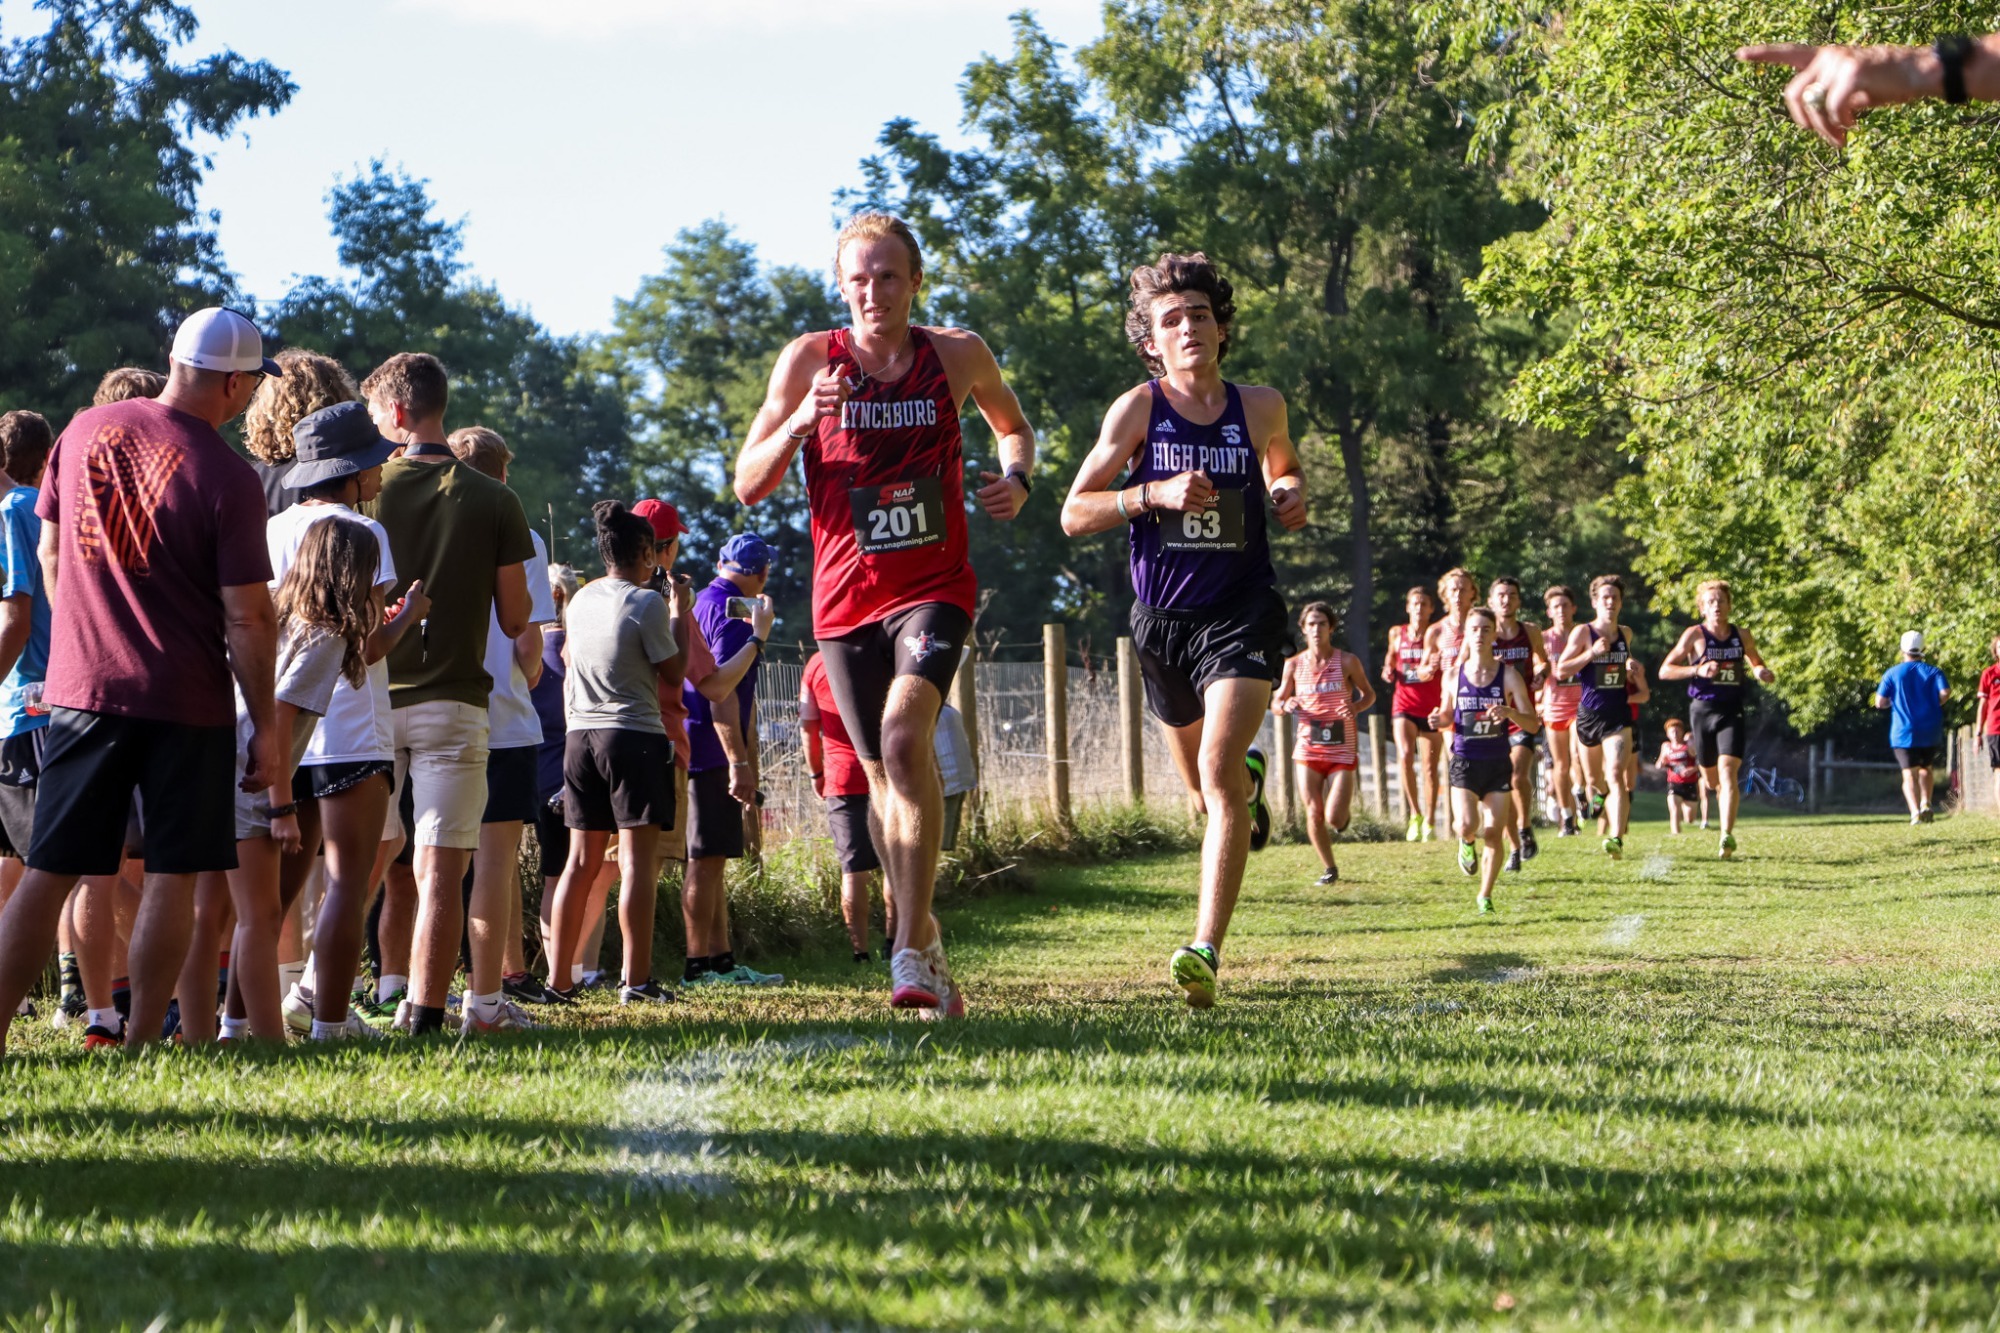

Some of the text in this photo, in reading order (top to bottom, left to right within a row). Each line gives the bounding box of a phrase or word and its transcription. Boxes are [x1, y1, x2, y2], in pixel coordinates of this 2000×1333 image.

[841, 399, 937, 429] LYNCHBURG
[1152, 442, 1249, 475] HIGH POINT
[868, 502, 928, 540] 201
[1182, 510, 1221, 539] 63
[864, 533, 939, 551] www.snaptiming.com
[1167, 541, 1237, 550] www.snaptiming.com
[1493, 647, 1530, 660] YNCHBURG
[1604, 673, 1619, 685] 57
[1720, 669, 1735, 681] 76
[1458, 696, 1478, 711] HIGH
[1322, 728, 1332, 741] 9
[1473, 721, 1491, 735] 47
